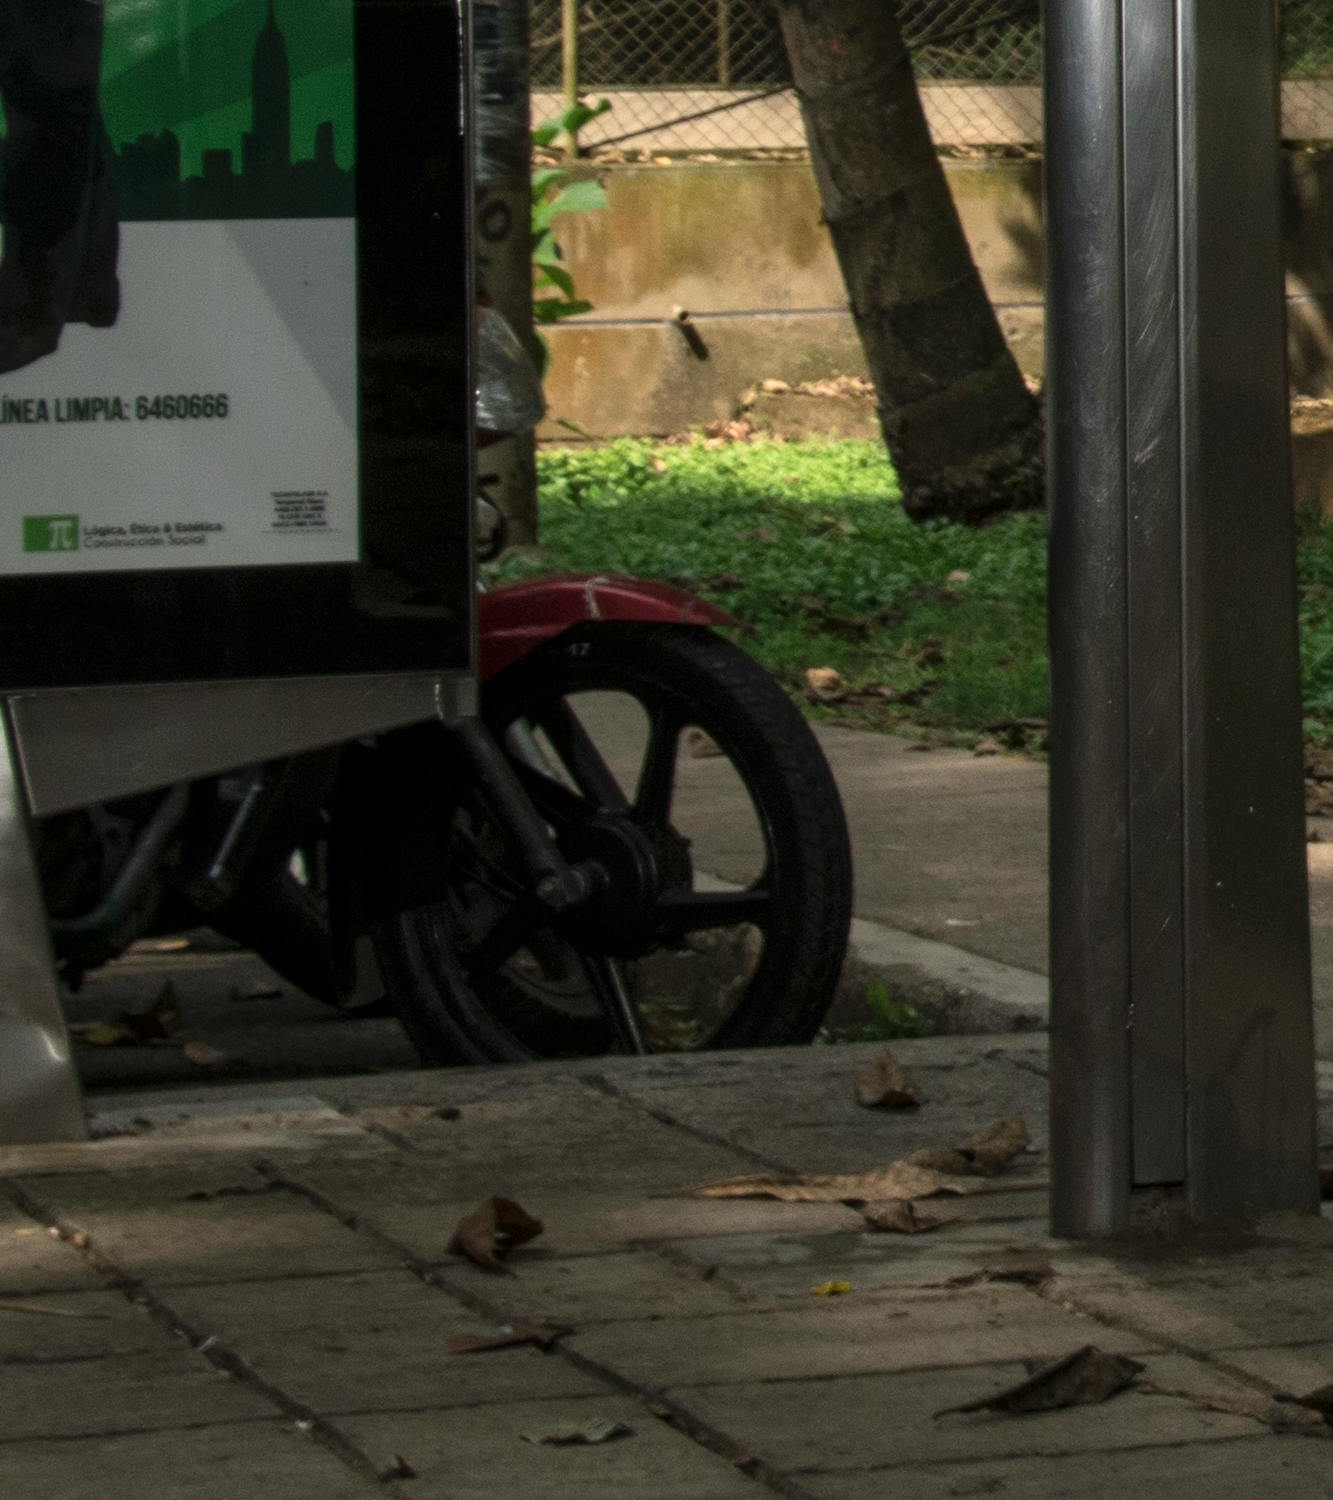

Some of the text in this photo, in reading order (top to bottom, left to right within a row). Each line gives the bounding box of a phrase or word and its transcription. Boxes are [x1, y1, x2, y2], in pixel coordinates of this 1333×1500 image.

[0, 393, 229, 424] ÍNEA LIMPIA: 6460666
